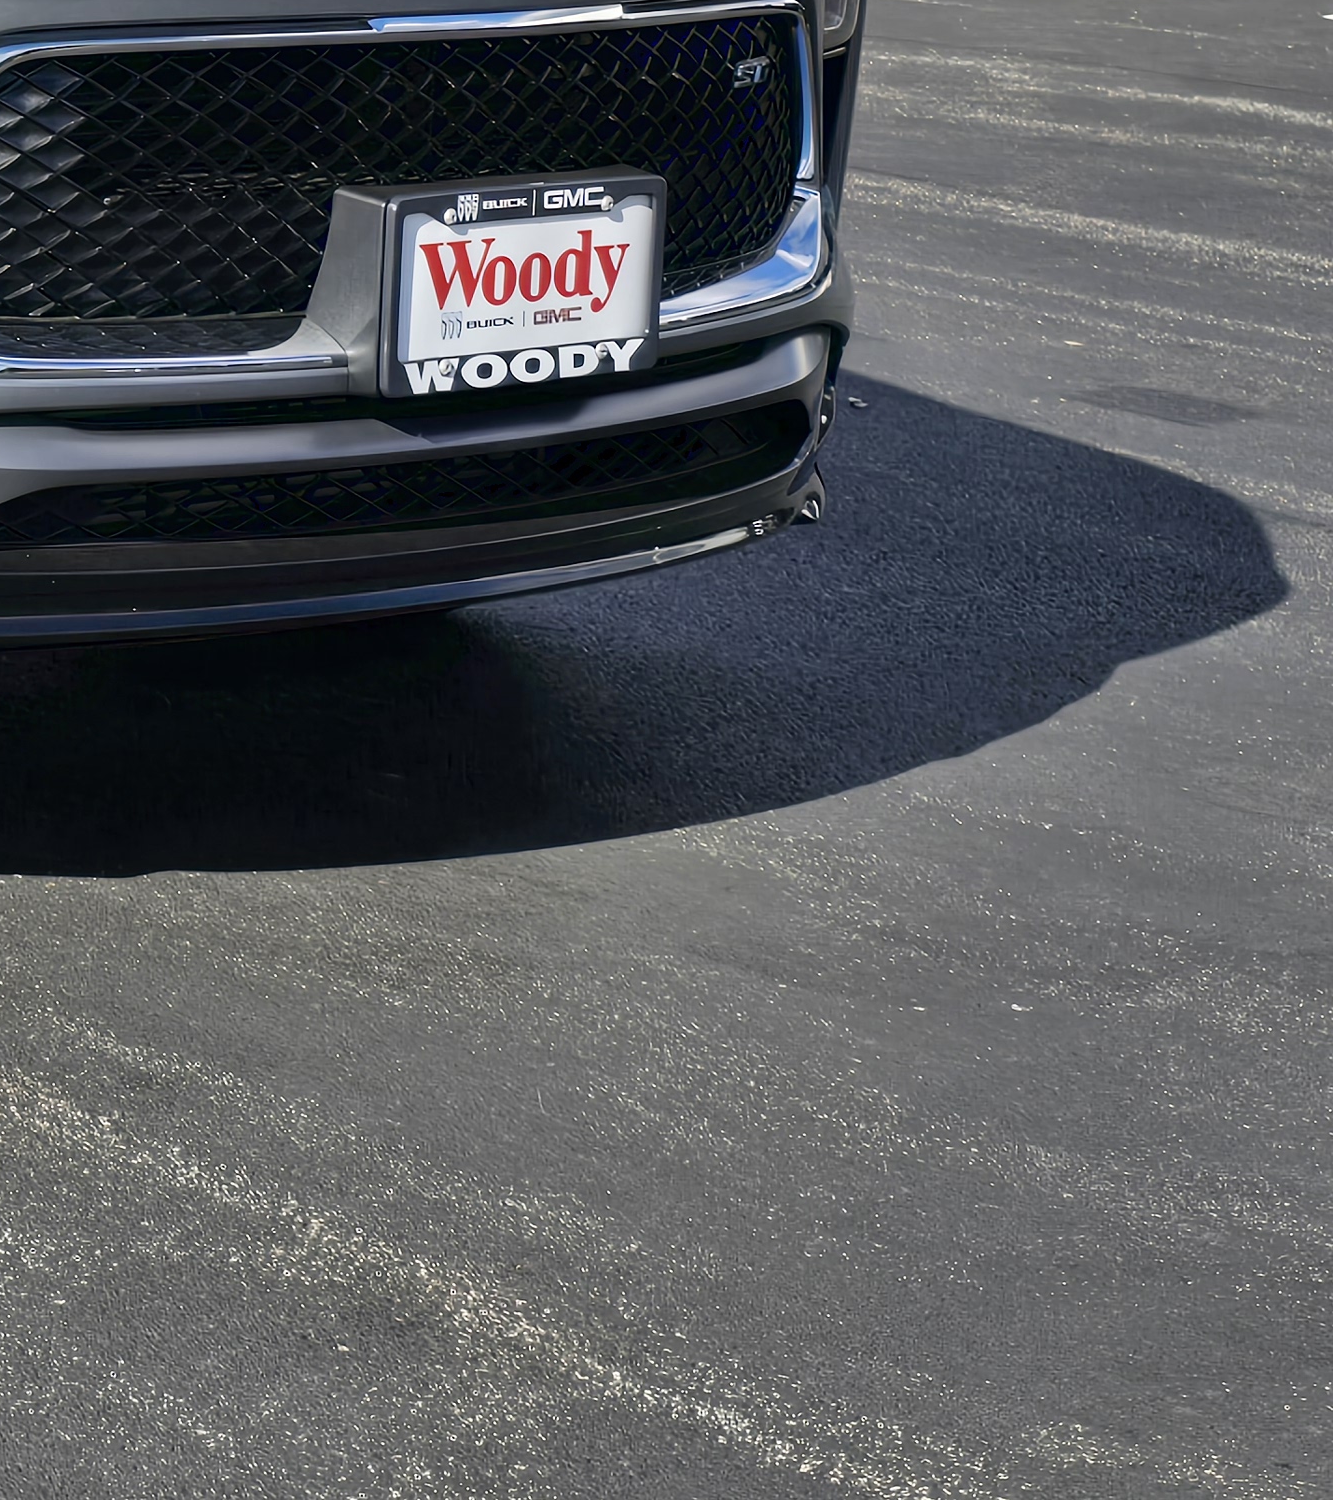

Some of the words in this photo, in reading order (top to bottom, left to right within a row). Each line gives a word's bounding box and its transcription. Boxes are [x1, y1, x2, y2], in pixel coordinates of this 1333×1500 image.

[482, 197, 528, 210] BUICK
[543, 186, 606, 210] GMC
[419, 229, 631, 313] Woody
[466, 316, 514, 329] BUICK
[533, 306, 583, 326] GMC
[403, 338, 645, 395] WOODY
